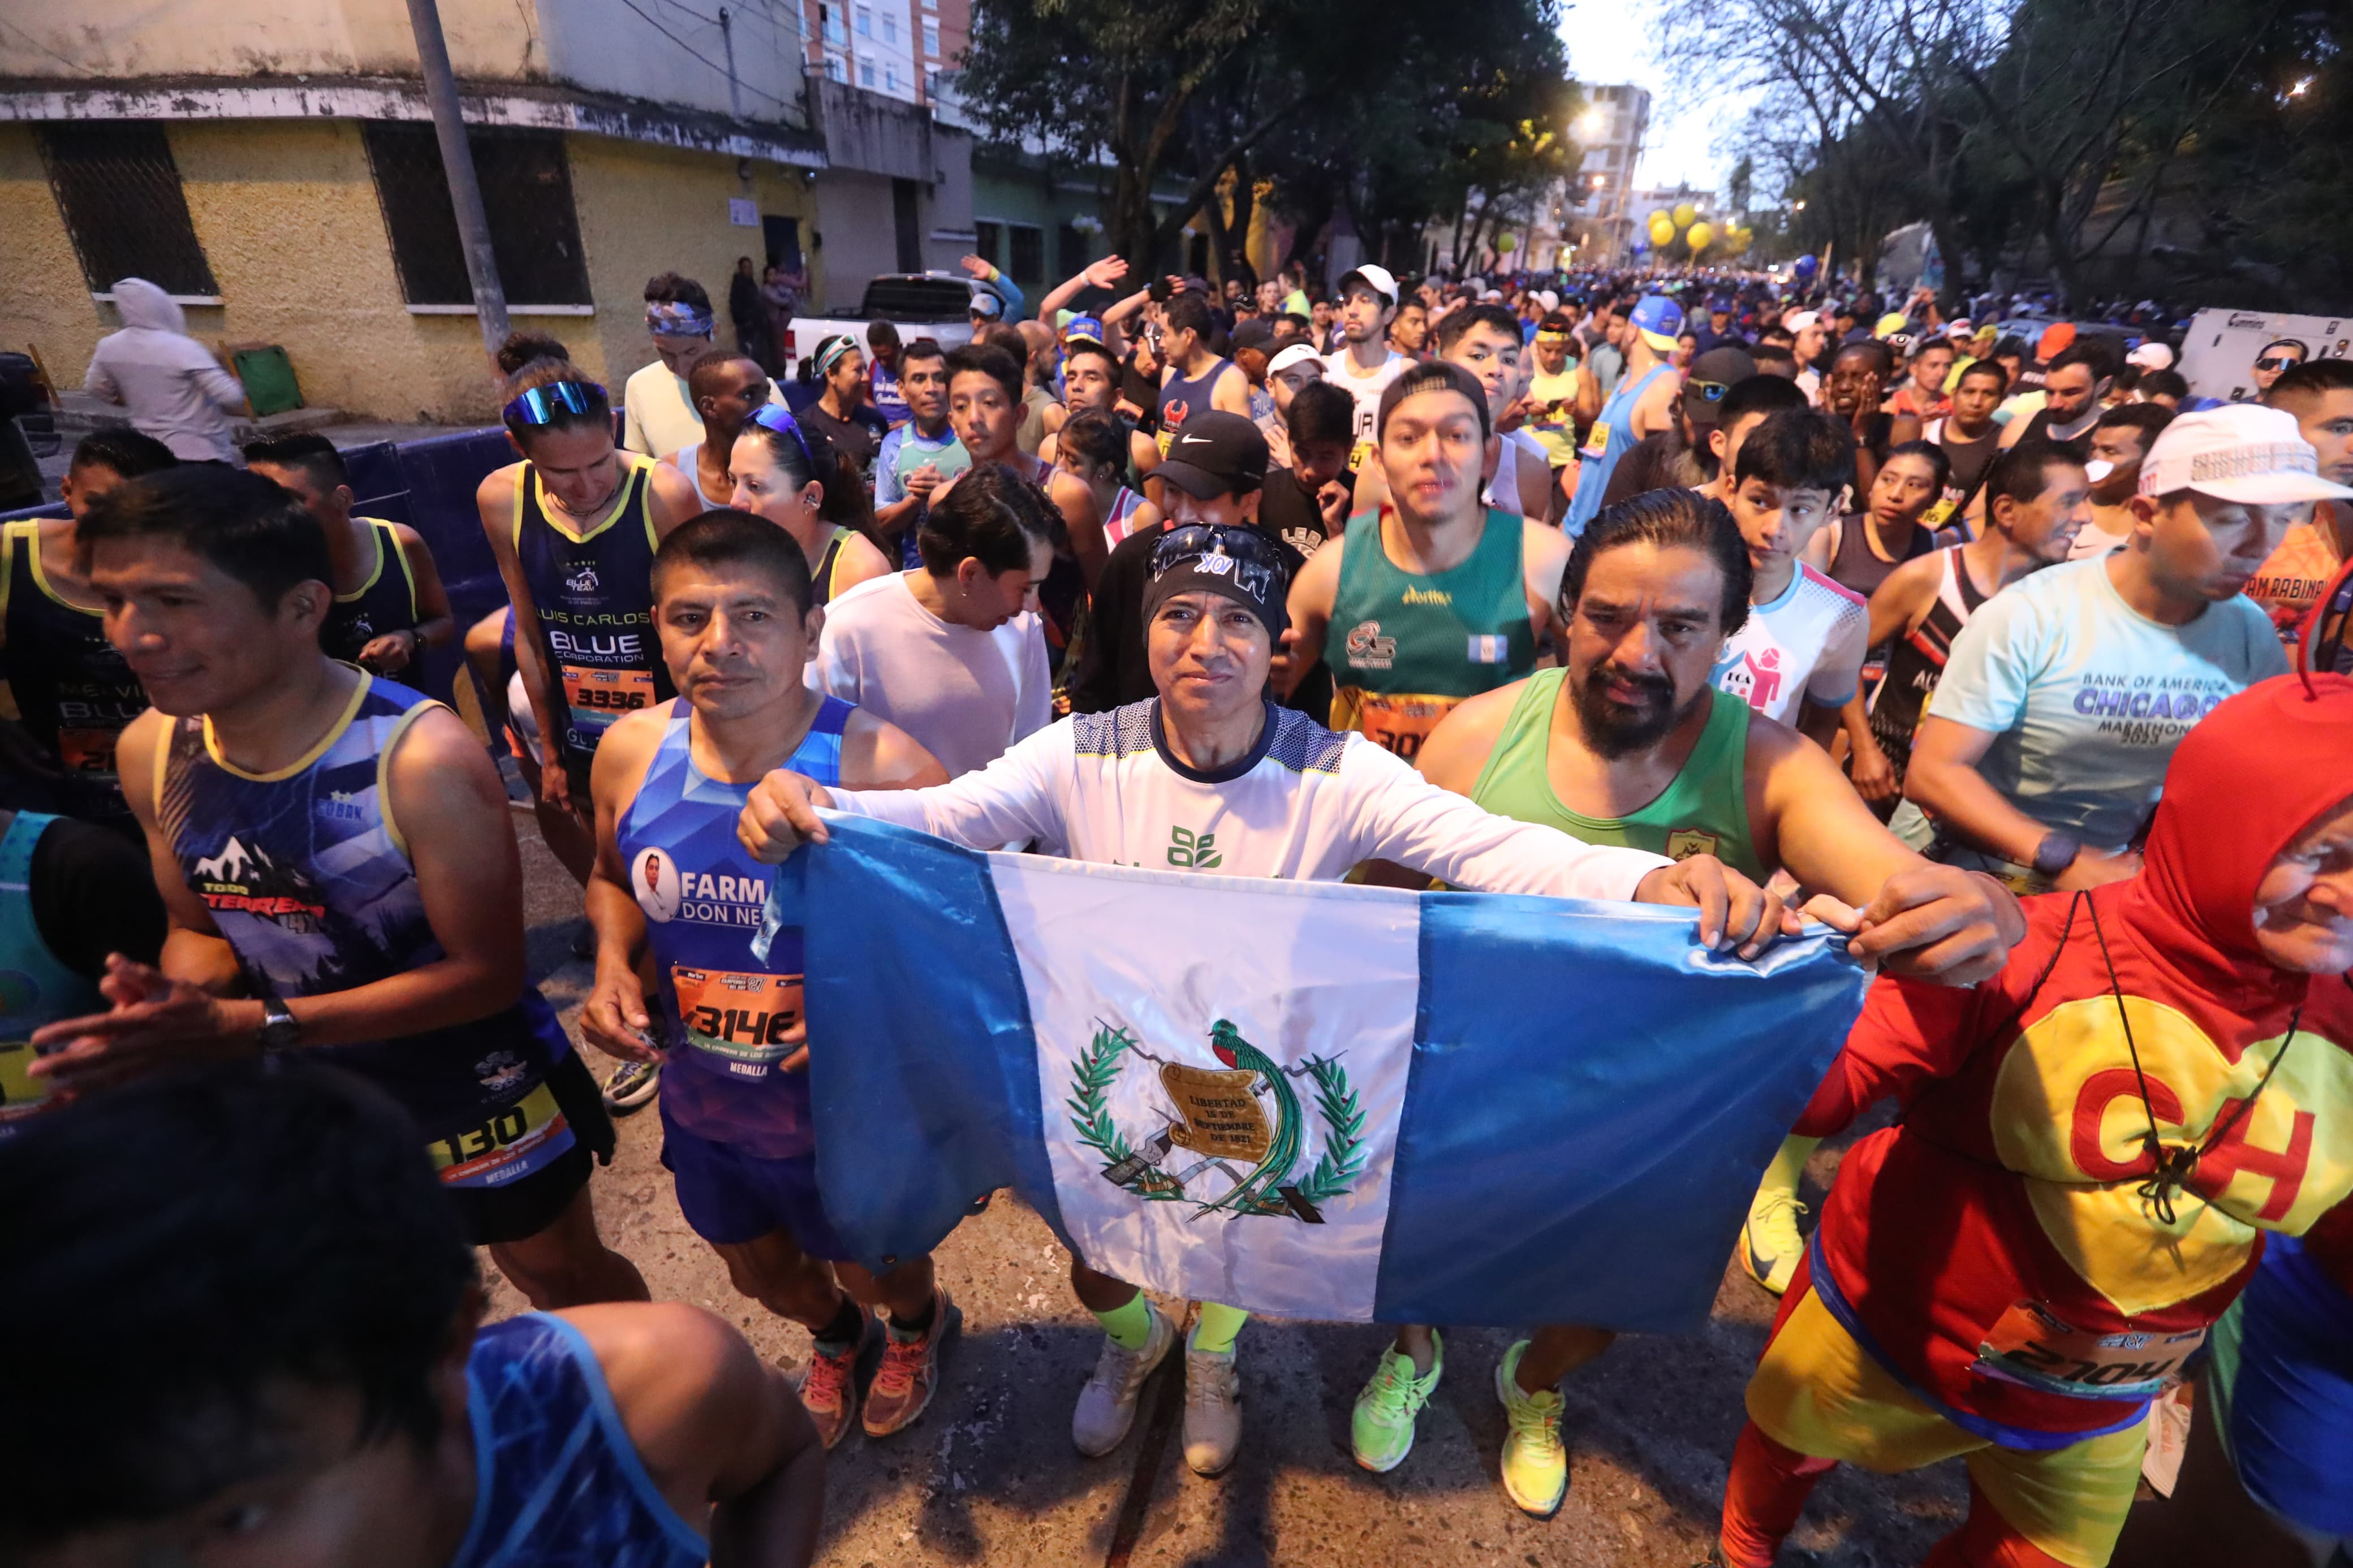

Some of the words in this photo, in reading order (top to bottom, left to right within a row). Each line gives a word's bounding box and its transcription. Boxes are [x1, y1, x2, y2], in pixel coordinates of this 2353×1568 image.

[2227, 312, 2265, 330] Cummins
[1281, 526, 1329, 549] LER
[574, 612, 650, 626] CARLOS
[549, 630, 643, 655] BLUE
[554, 651, 644, 663] CORPORATION
[2083, 673, 2127, 688] BANK
[2133, 675, 2153, 689] OF
[576, 688, 647, 710] 3336
[2073, 688, 2223, 720] CHICAGO
[59, 702, 143, 720] BLU
[2097, 719, 2192, 736] MARATHON
[2121, 733, 2161, 745] 2023
[203, 882, 249, 895] TODO
[682, 902, 729, 922] DON
[736, 908, 765, 925] NE
[748, 977, 768, 993] 87
[730, 1061, 768, 1077] MEDALLA
[1189, 1095, 1246, 1108] LIBERTAD
[1210, 1133, 1225, 1142] DE
[485, 1160, 529, 1185] MEDALLA
